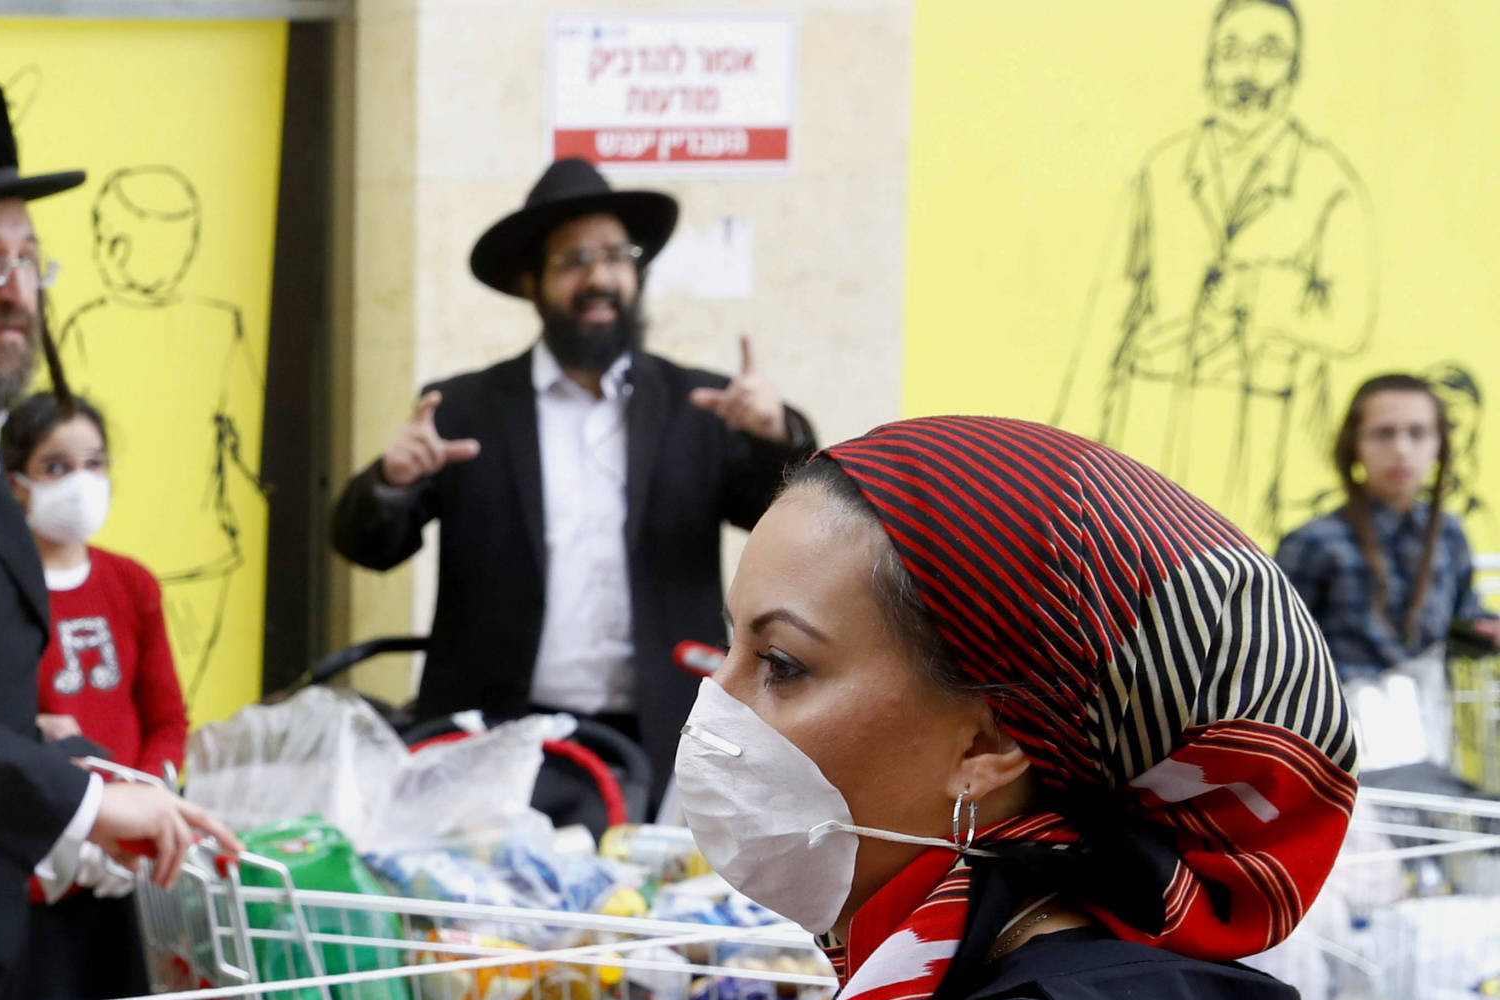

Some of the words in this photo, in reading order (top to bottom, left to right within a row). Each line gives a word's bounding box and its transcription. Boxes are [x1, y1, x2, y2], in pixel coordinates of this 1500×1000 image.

[589, 43, 686, 83] להדביק
[698, 48, 754, 74] אסור
[627, 87, 719, 112] מודעות
